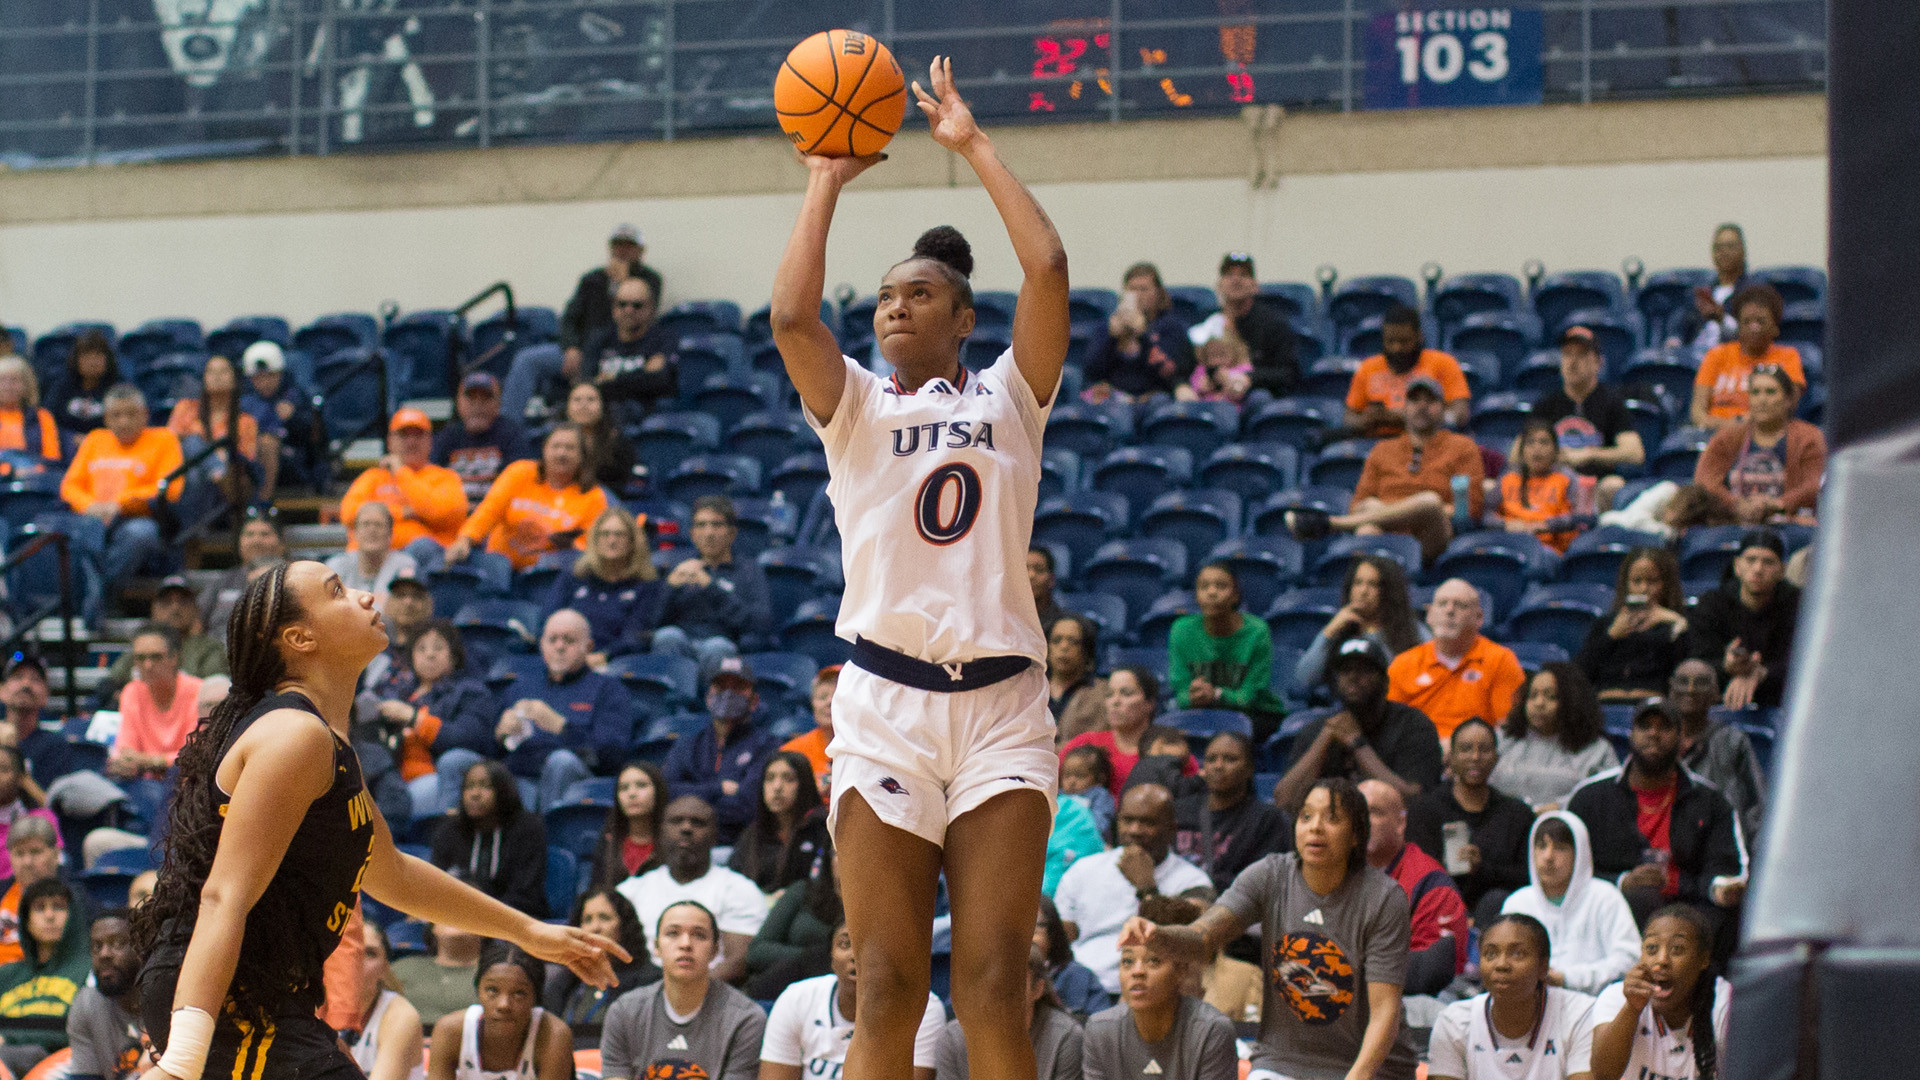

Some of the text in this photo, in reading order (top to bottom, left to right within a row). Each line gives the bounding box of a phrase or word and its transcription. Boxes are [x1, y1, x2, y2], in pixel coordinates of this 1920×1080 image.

[1396, 9, 1511, 33] SECTION
[1396, 32, 1509, 84] 103
[890, 421, 996, 457] UTSA
[914, 461, 982, 547] 0
